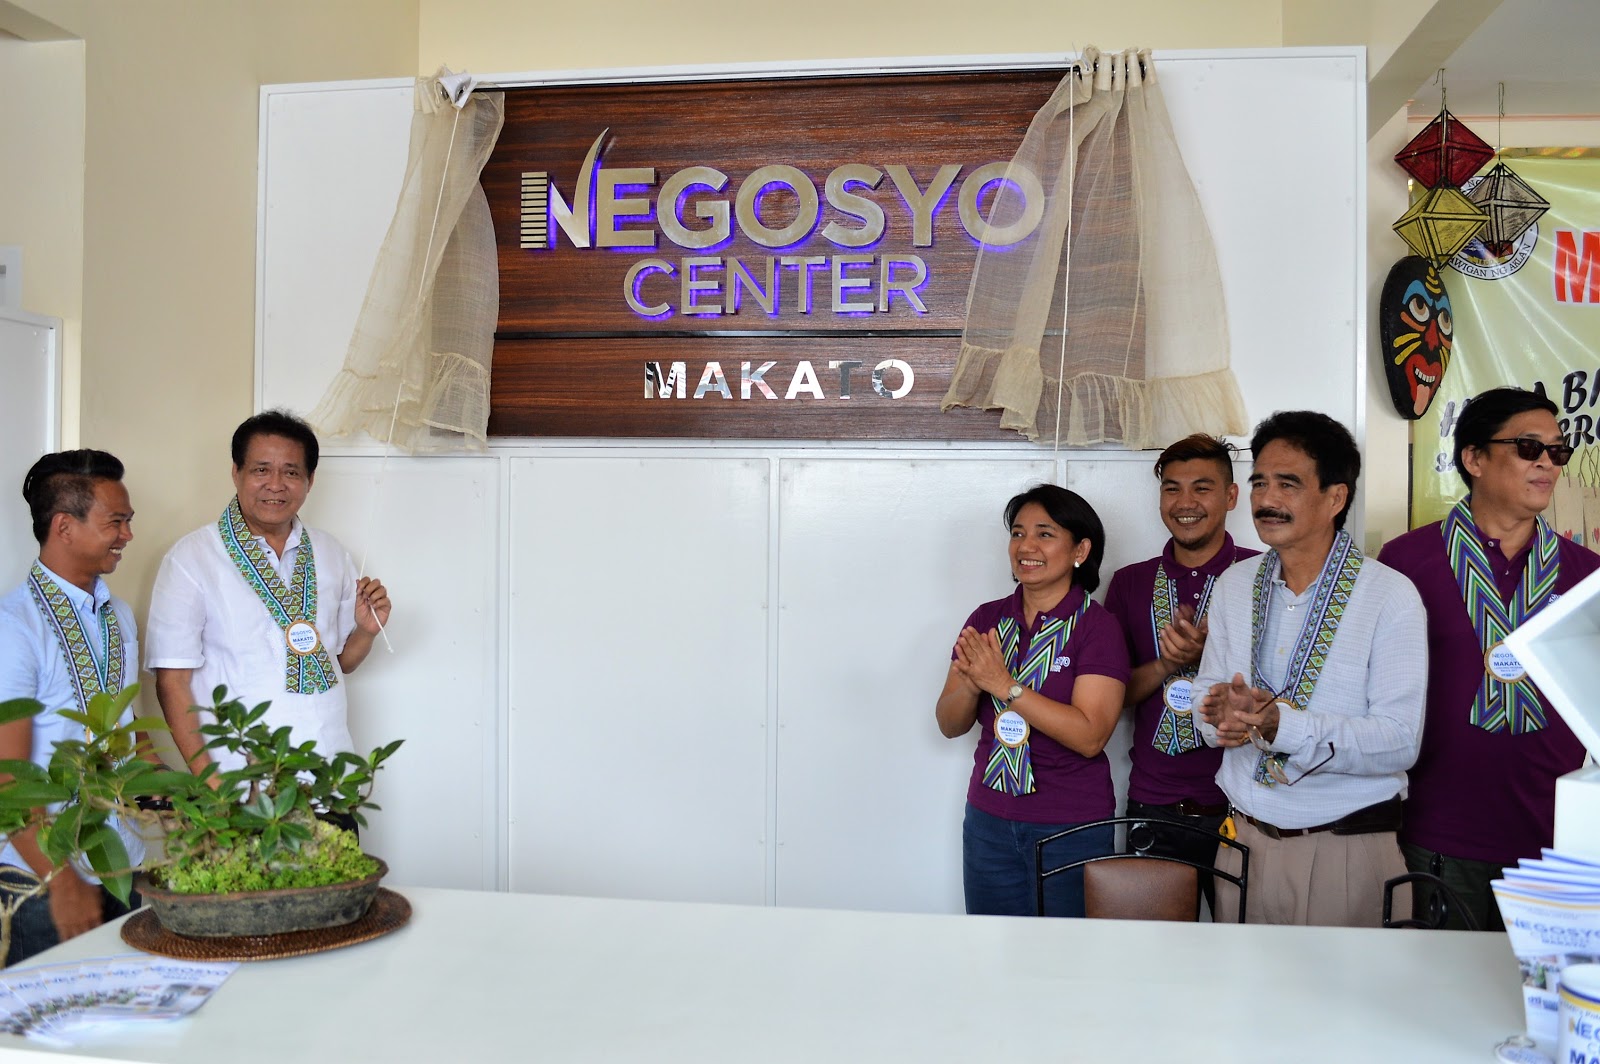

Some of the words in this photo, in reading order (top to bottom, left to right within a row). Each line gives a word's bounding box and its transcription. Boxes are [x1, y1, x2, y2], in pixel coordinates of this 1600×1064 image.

[520, 127, 1045, 250] NEGOSYO
[1491, 266, 1508, 277] NG
[1509, 243, 1531, 271] AKLAN
[623, 254, 929, 316] CENTER
[643, 358, 916, 400] MAKATO
[1000, 718, 1024, 726] NEGOSYO
